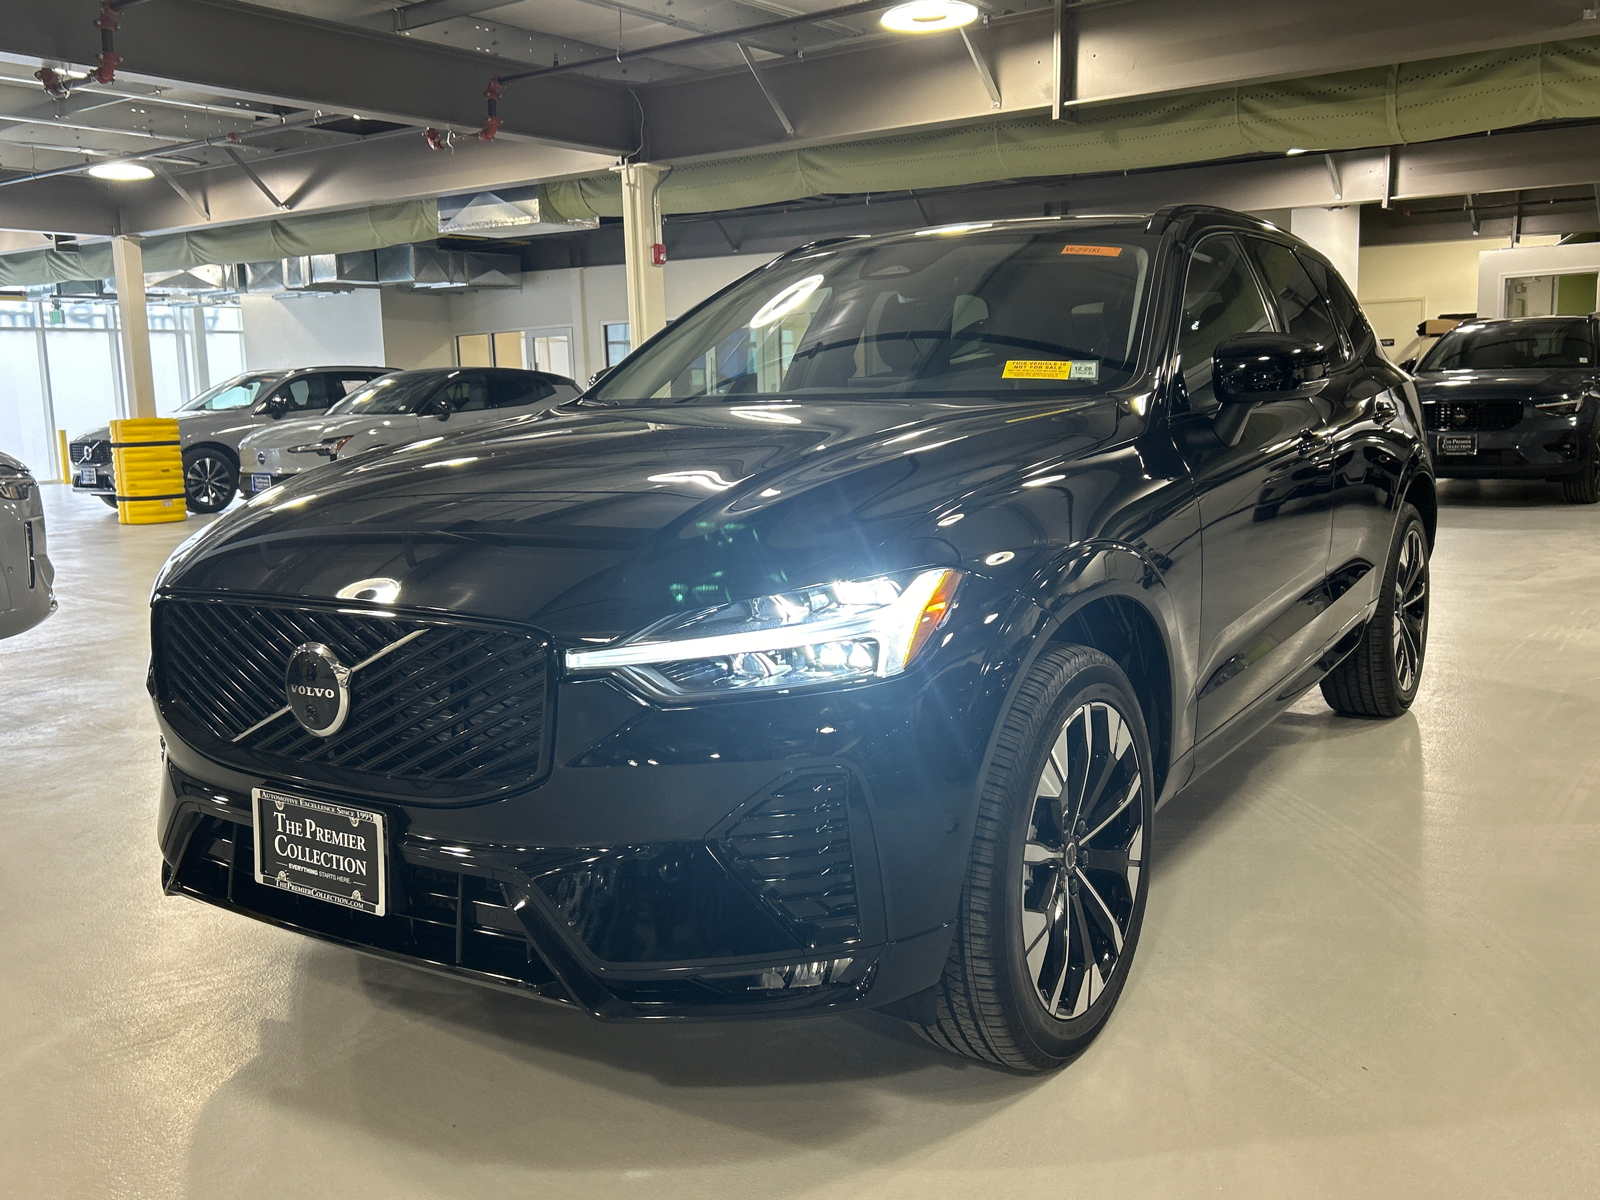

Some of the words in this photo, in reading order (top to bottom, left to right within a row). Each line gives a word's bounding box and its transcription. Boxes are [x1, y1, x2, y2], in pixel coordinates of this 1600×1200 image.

[290, 683, 335, 699] VOLVO
[262, 790, 299, 805] AUTOMOTIVE
[299, 799, 336, 813] EXCELLENCE
[336, 807, 355, 818] SINCE
[356, 811, 373, 822] 1995
[273, 811, 303, 838] THE
[304, 818, 367, 852] PREMIER
[274, 834, 368, 877] COLLECTION
[288, 862, 319, 876] EVERYTHING
[318, 870, 337, 882] STARTS
